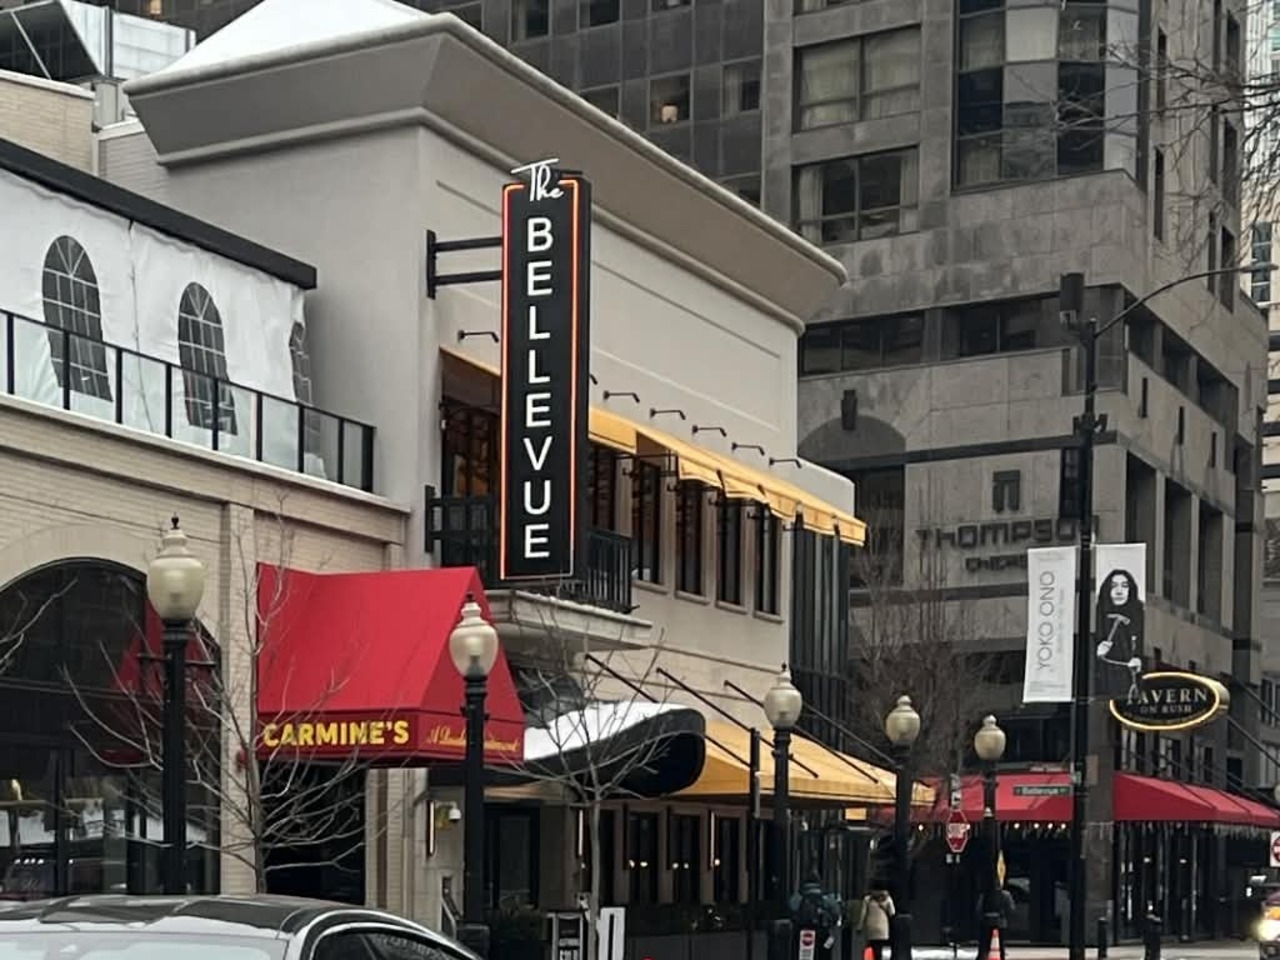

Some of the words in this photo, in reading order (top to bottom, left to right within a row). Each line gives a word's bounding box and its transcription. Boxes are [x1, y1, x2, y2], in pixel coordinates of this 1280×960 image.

[511, 158, 564, 201] The
[523, 216, 554, 558] BELLEVUE
[1039, 570, 1055, 617] ONO
[1036, 621, 1054, 672] YOKO
[263, 720, 410, 748] CARMINE'S
